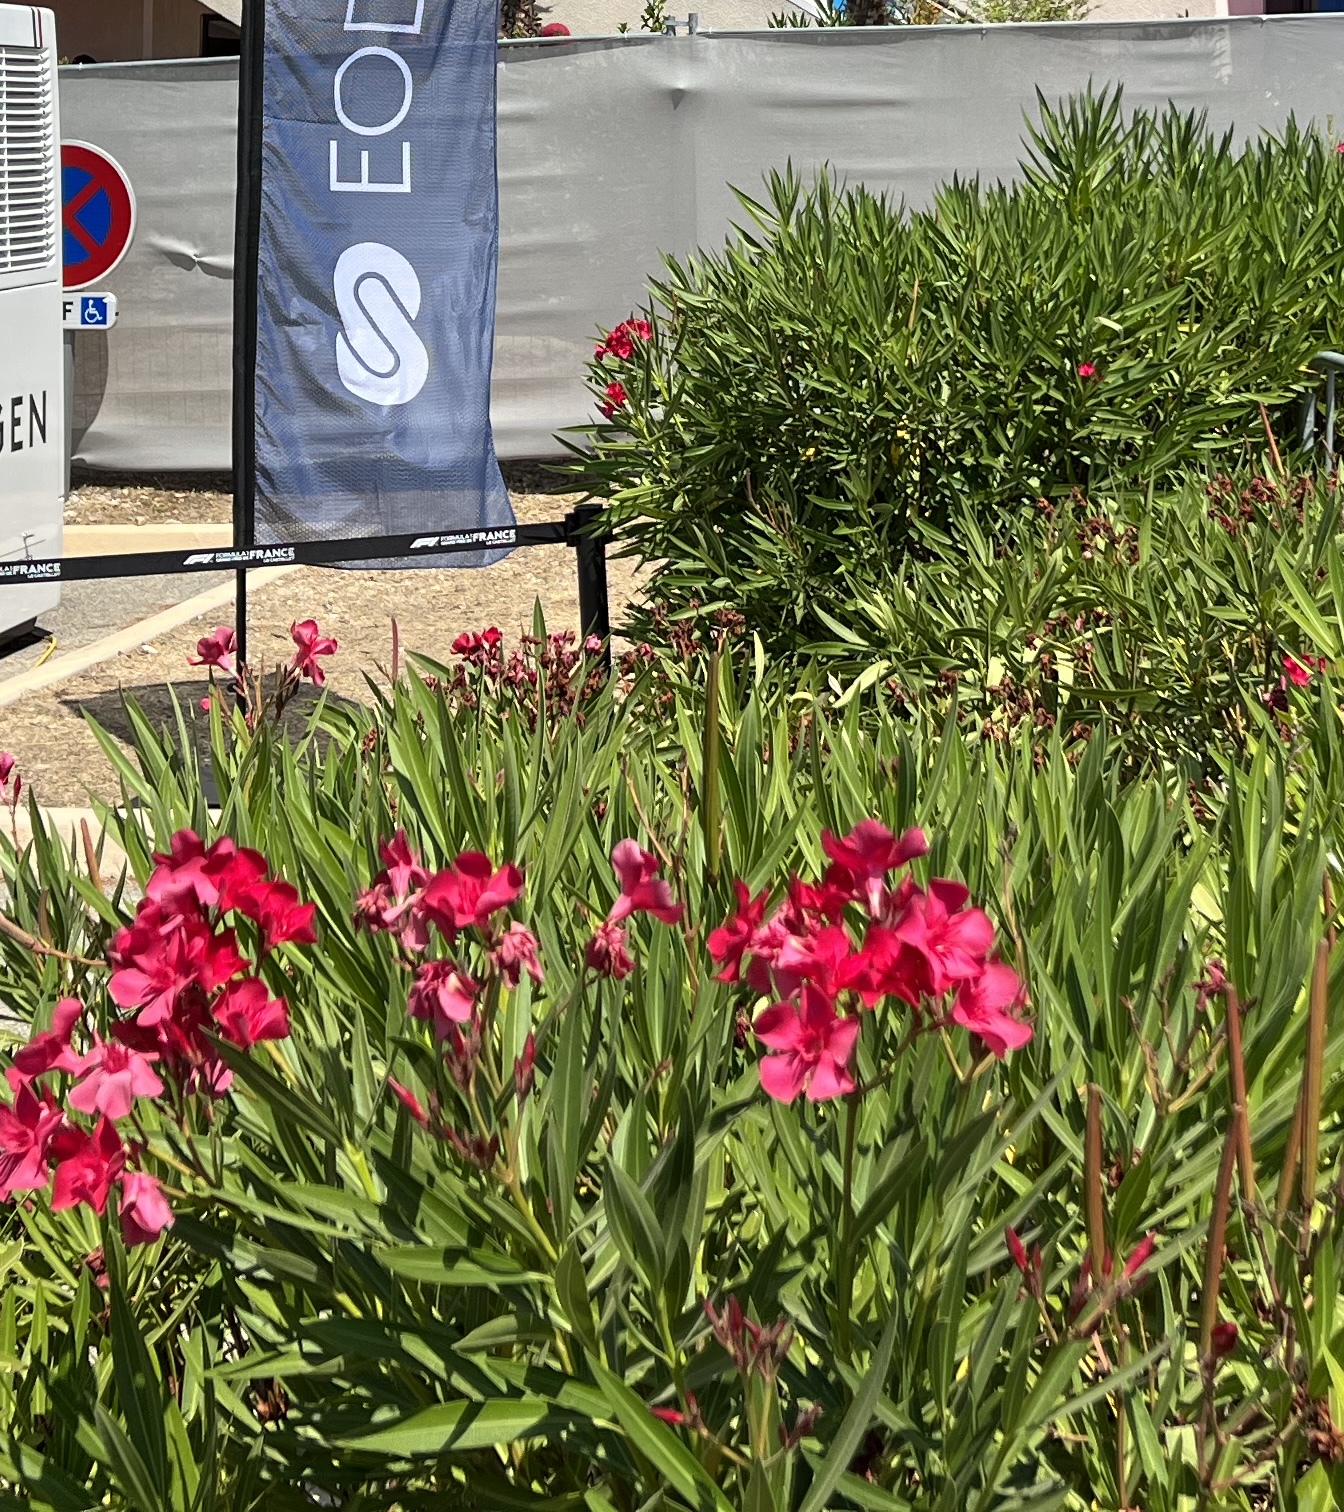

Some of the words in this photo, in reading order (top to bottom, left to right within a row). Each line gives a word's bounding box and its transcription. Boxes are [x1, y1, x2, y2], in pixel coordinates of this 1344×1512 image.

[472, 529, 516, 543] FRANCE
[249, 547, 296, 560] FRANCE
[12, 562, 61, 576] FRANCE
